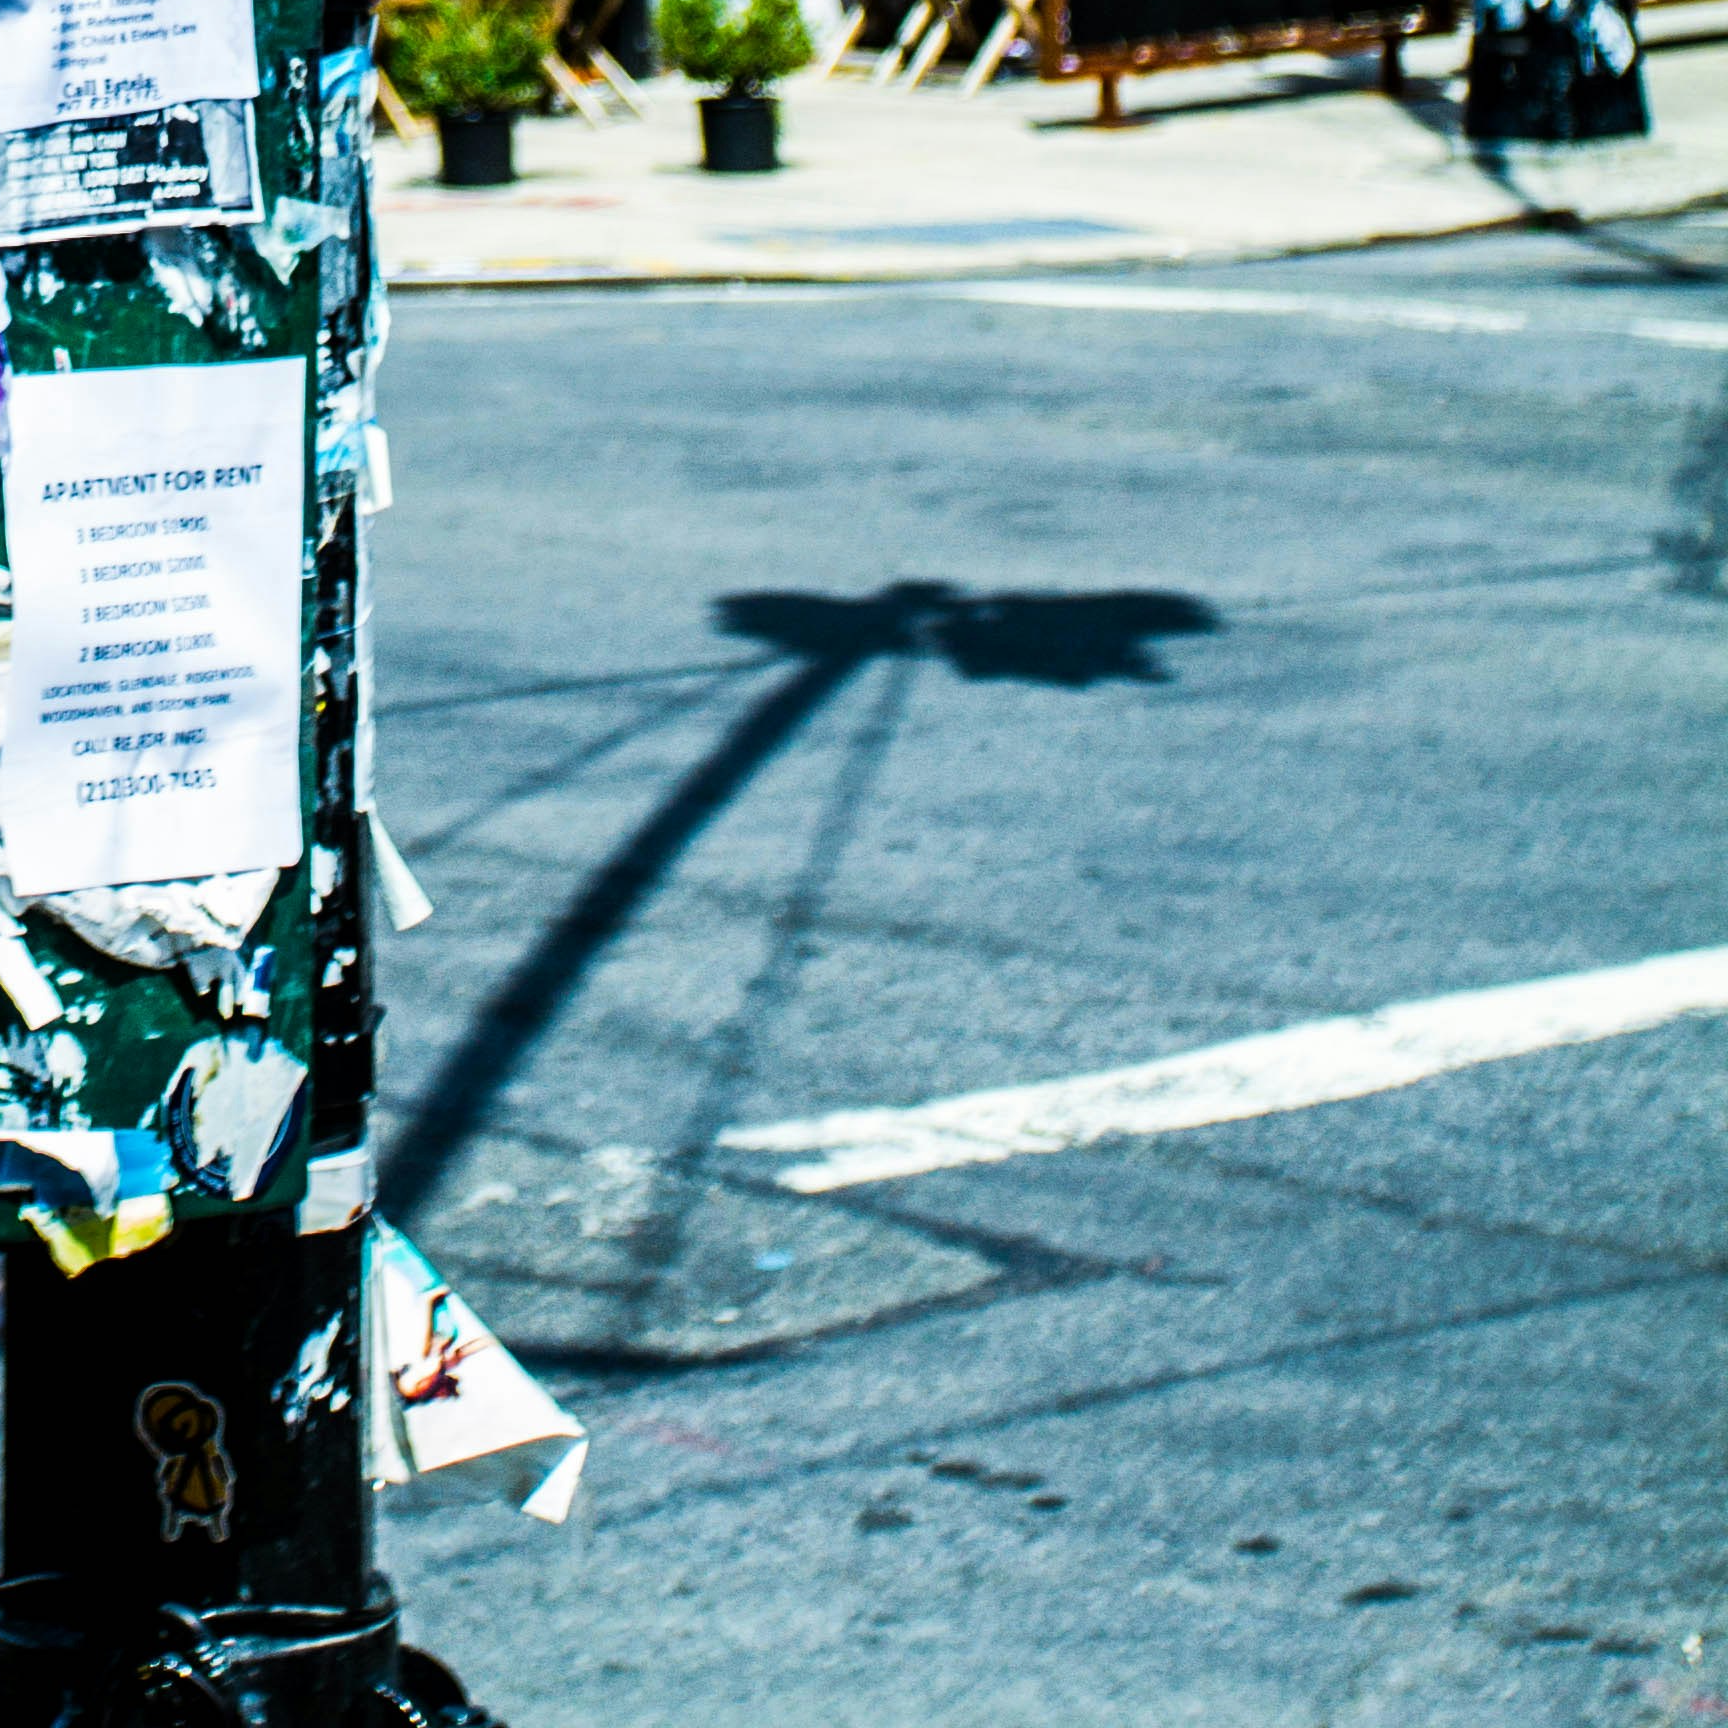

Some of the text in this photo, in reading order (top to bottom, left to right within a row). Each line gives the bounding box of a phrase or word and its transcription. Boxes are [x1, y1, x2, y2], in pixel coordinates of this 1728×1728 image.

[41, 464, 263, 503] APARTMENT FOR RENT
